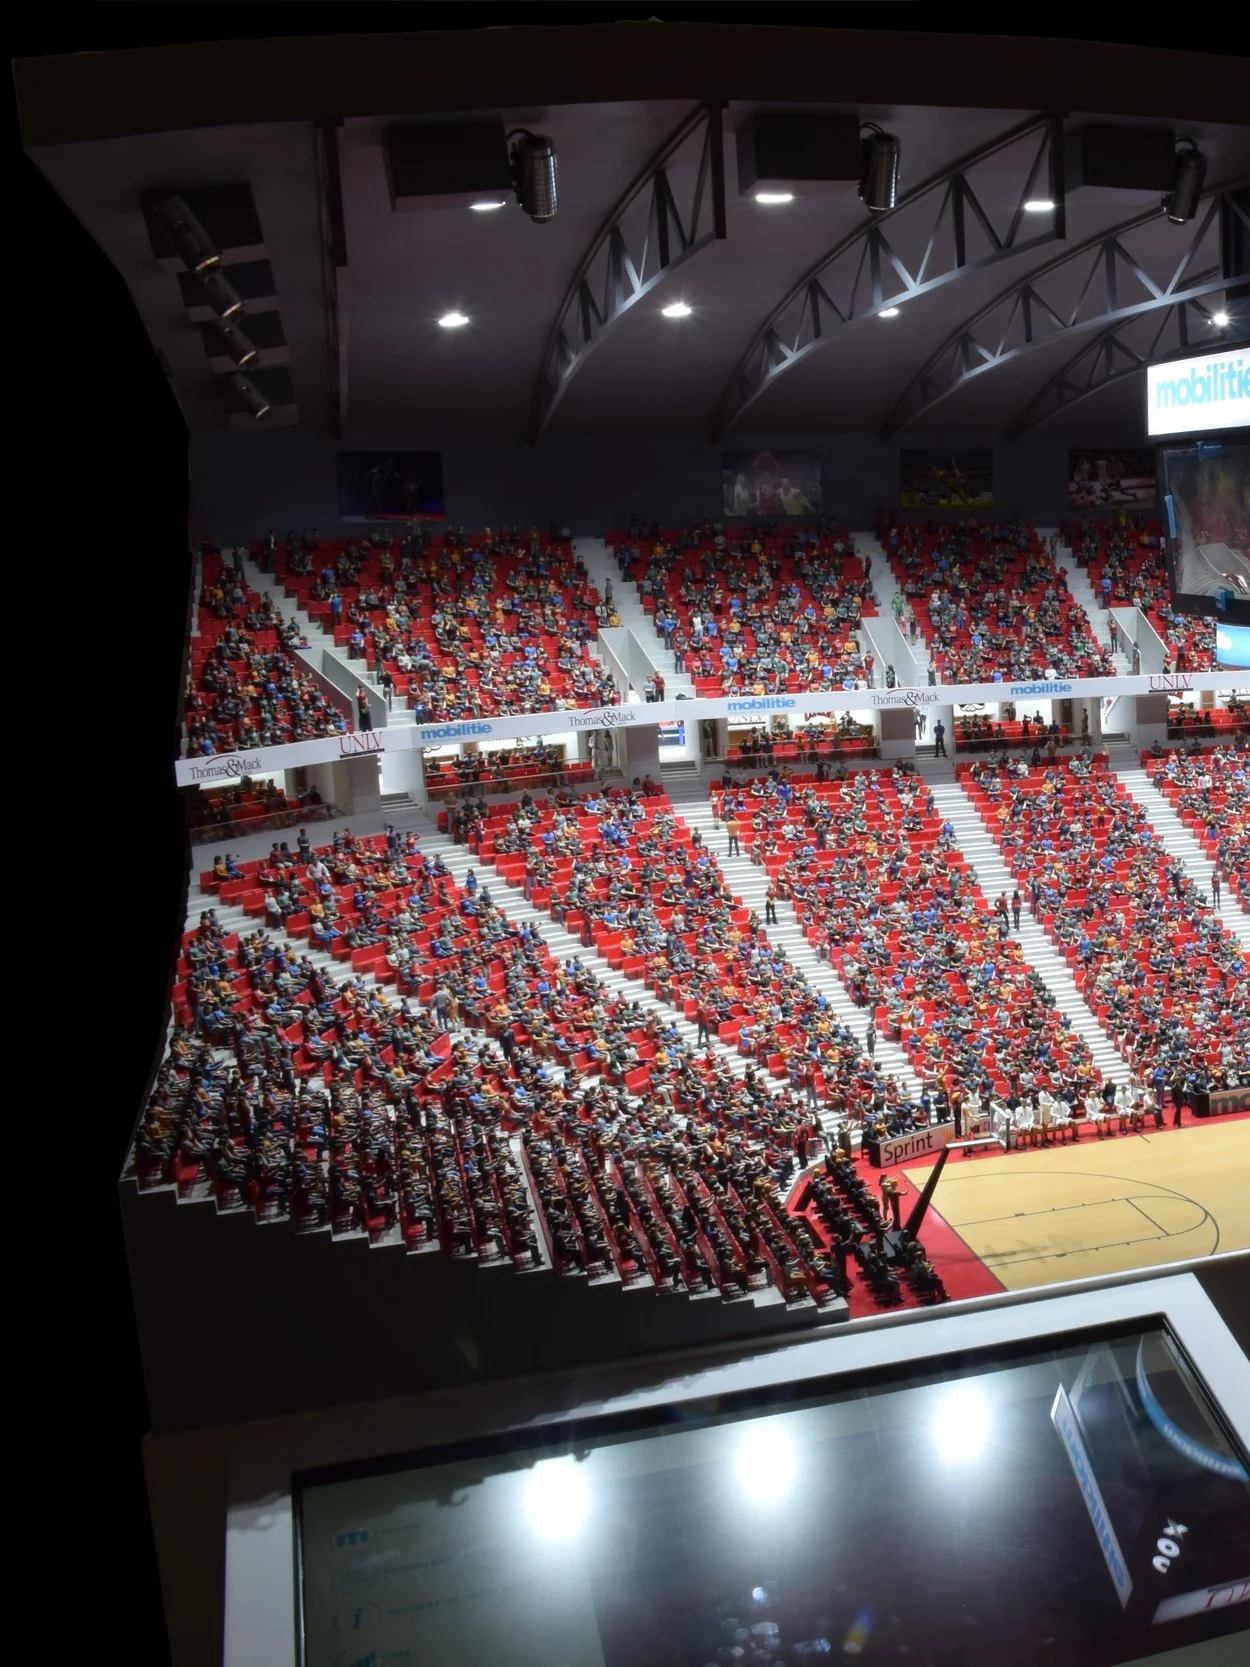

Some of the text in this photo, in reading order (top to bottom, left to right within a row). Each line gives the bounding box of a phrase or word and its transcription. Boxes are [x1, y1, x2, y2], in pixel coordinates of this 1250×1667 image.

[1010, 682, 1072, 696] mobilitie
[1149, 675, 1193, 689] UNLV
[727, 697, 796, 711] mobilitie
[420, 722, 493, 740] mobilitie
[339, 731, 385, 754] UNLV
[884, 1132, 933, 1164] Sprint
